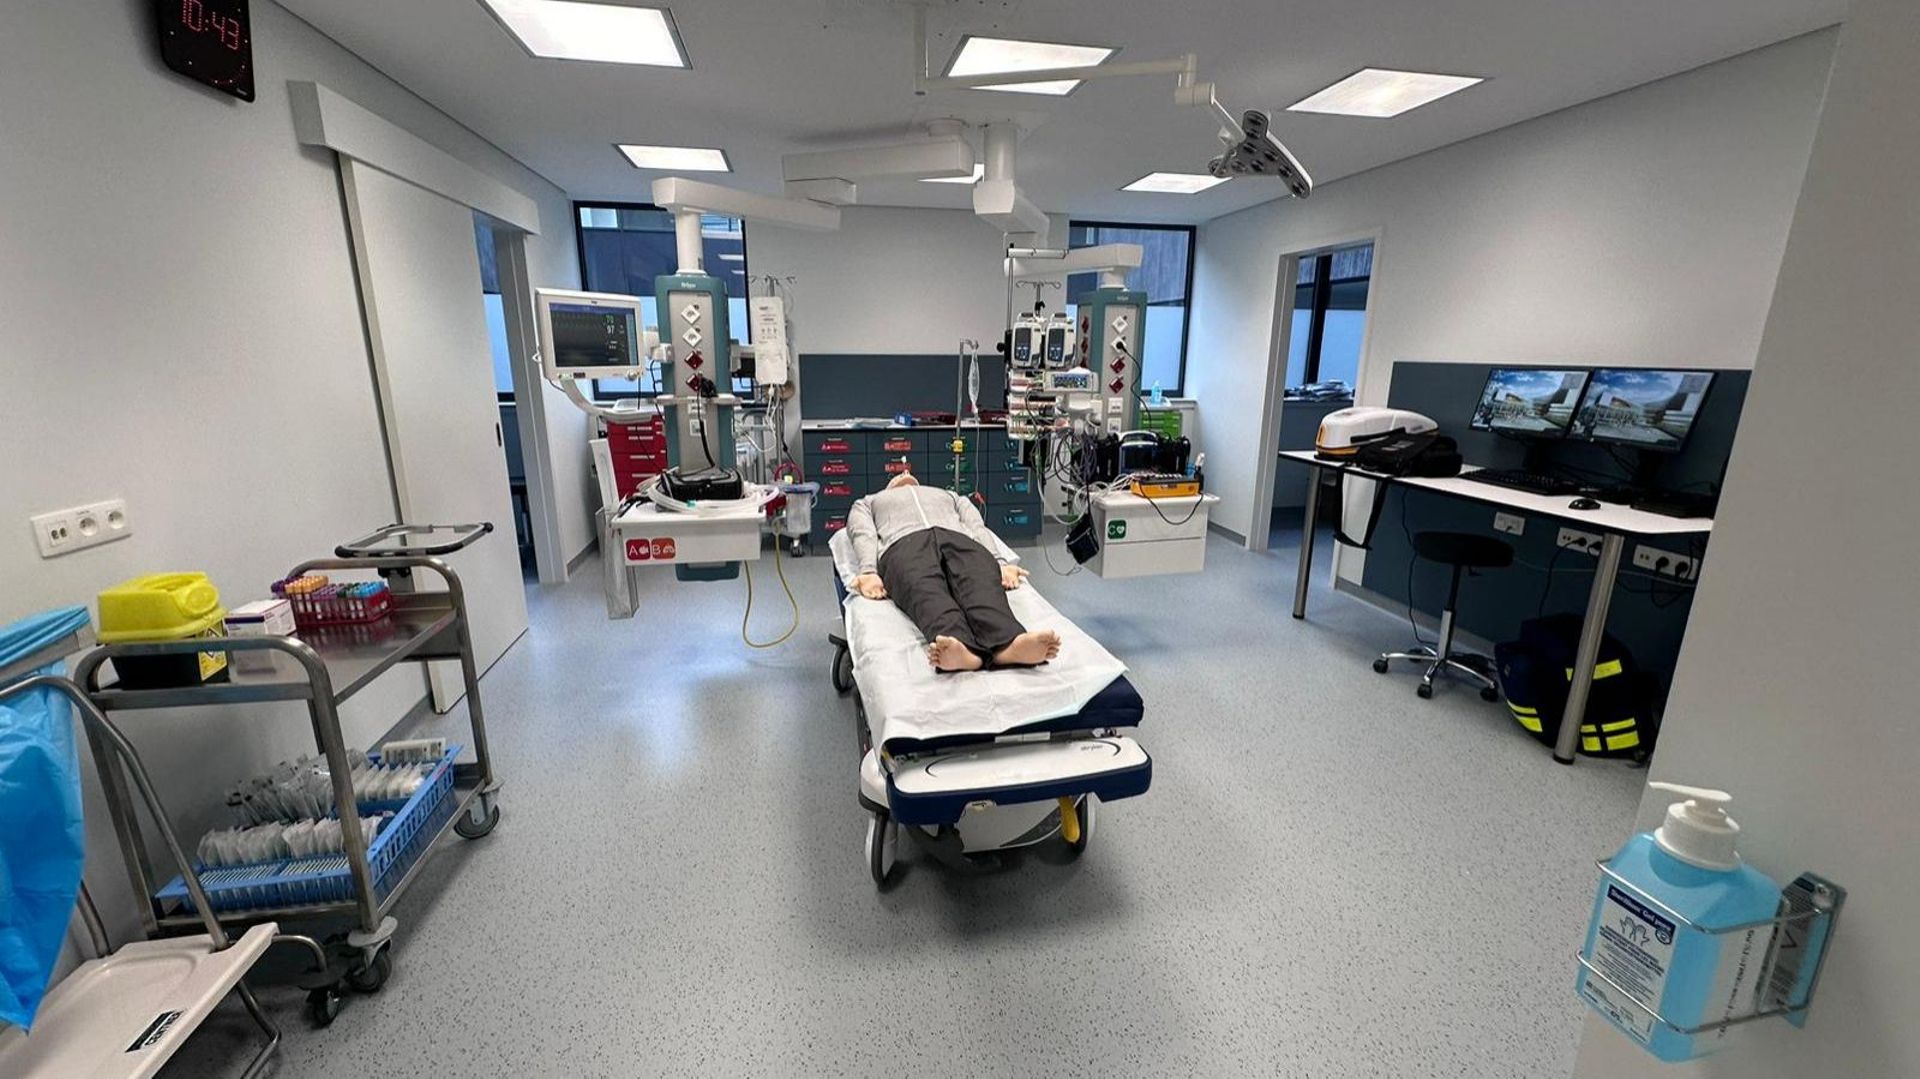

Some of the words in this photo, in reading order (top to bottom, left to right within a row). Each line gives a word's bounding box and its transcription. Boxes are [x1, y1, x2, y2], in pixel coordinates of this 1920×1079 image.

[182, 0, 240, 50] 10:43
[607, 325, 615, 334] 97
[1108, 525, 1116, 535] C
[629, 545, 638, 556] A
[652, 544, 661, 556] B
